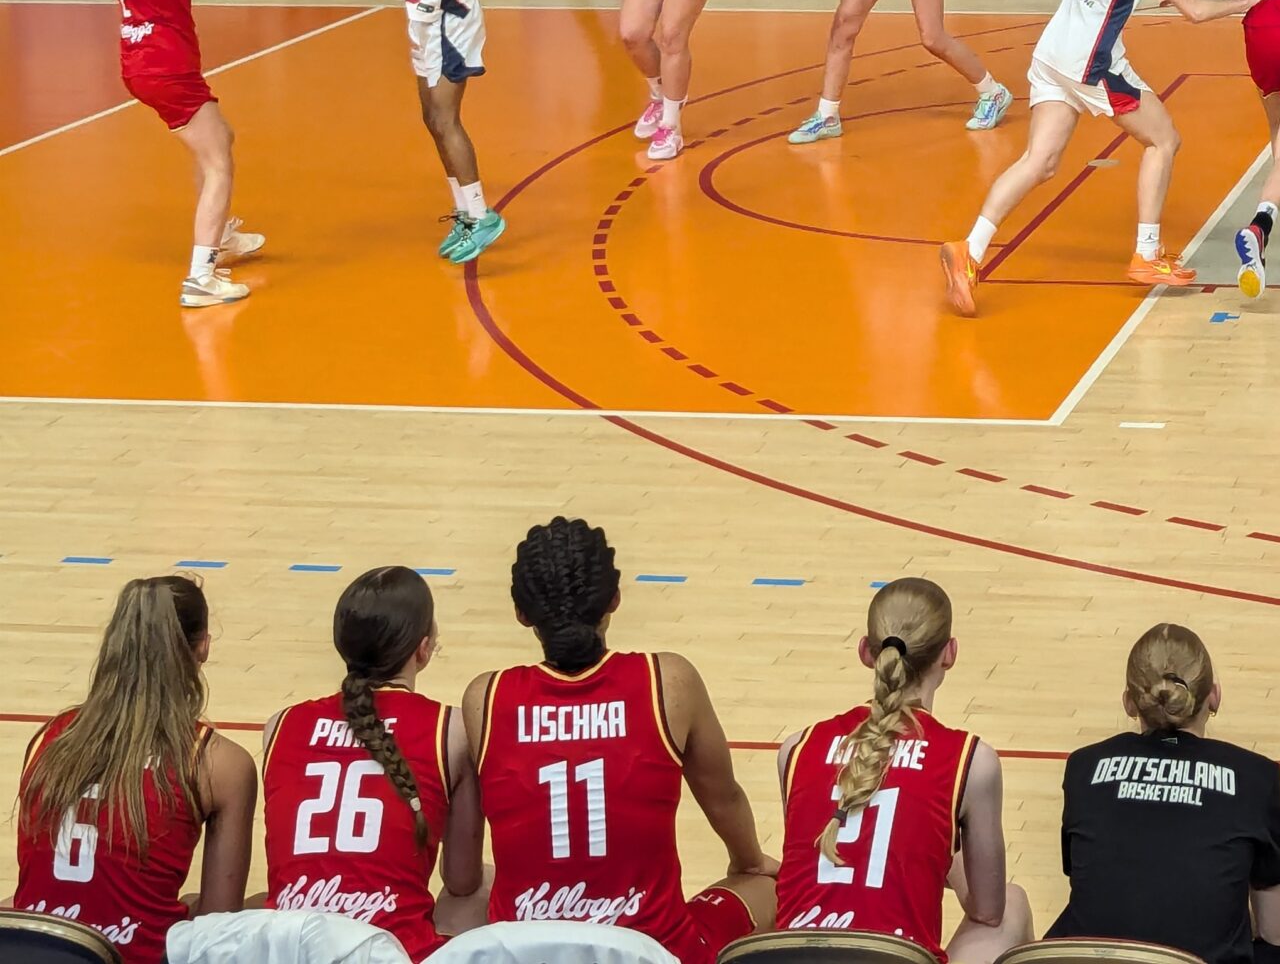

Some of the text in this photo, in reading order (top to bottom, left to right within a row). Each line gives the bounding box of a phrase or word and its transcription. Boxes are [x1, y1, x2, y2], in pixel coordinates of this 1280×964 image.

[517, 700, 627, 742] LISCHKA
[293, 760, 385, 855] 26
[538, 758, 607, 859] 11
[1091, 756, 1236, 796] DEUTSCHLAND
[1117, 781, 1203, 806] BASKETBALL
[53, 783, 99, 883] 6
[816, 785, 900, 889] 21
[514, 882, 647, 925] Kellogg's
